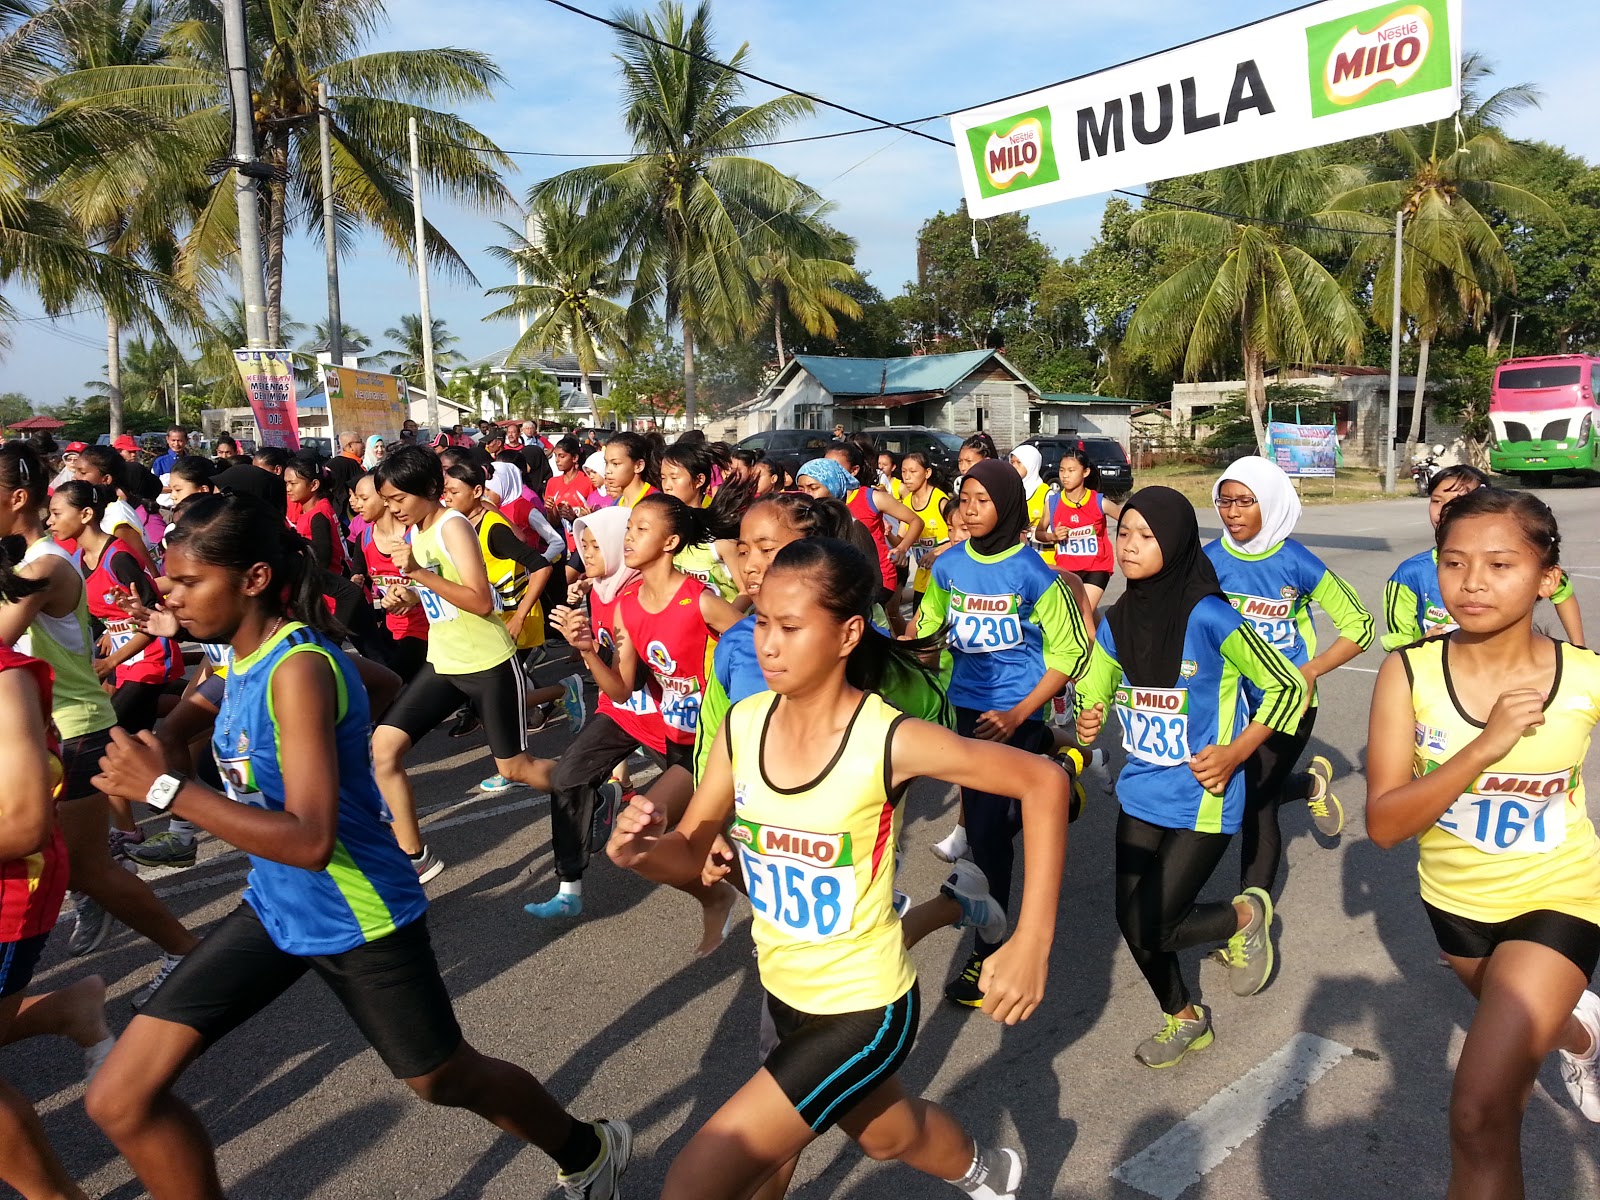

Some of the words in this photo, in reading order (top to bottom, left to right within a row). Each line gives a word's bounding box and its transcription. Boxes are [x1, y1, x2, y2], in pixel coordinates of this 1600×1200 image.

[1377, 21, 1418, 42] Nestlé
[1332, 36, 1421, 85] MILO
[1076, 59, 1276, 162] MULA
[1009, 130, 1034, 145] Nestlé
[989, 141, 1037, 174] MILO
[1070, 528, 1091, 537] MILO
[967, 597, 1008, 611] MILO
[1246, 600, 1289, 617] MILO
[1428, 608, 1444, 618] MILO
[109, 622, 130, 633] MIL
[663, 678, 691, 695] MILO
[1135, 692, 1179, 710] MILO
[1481, 776, 1565, 797] MILO
[766, 830, 834, 862] MILO
[741, 849, 841, 935] E158
